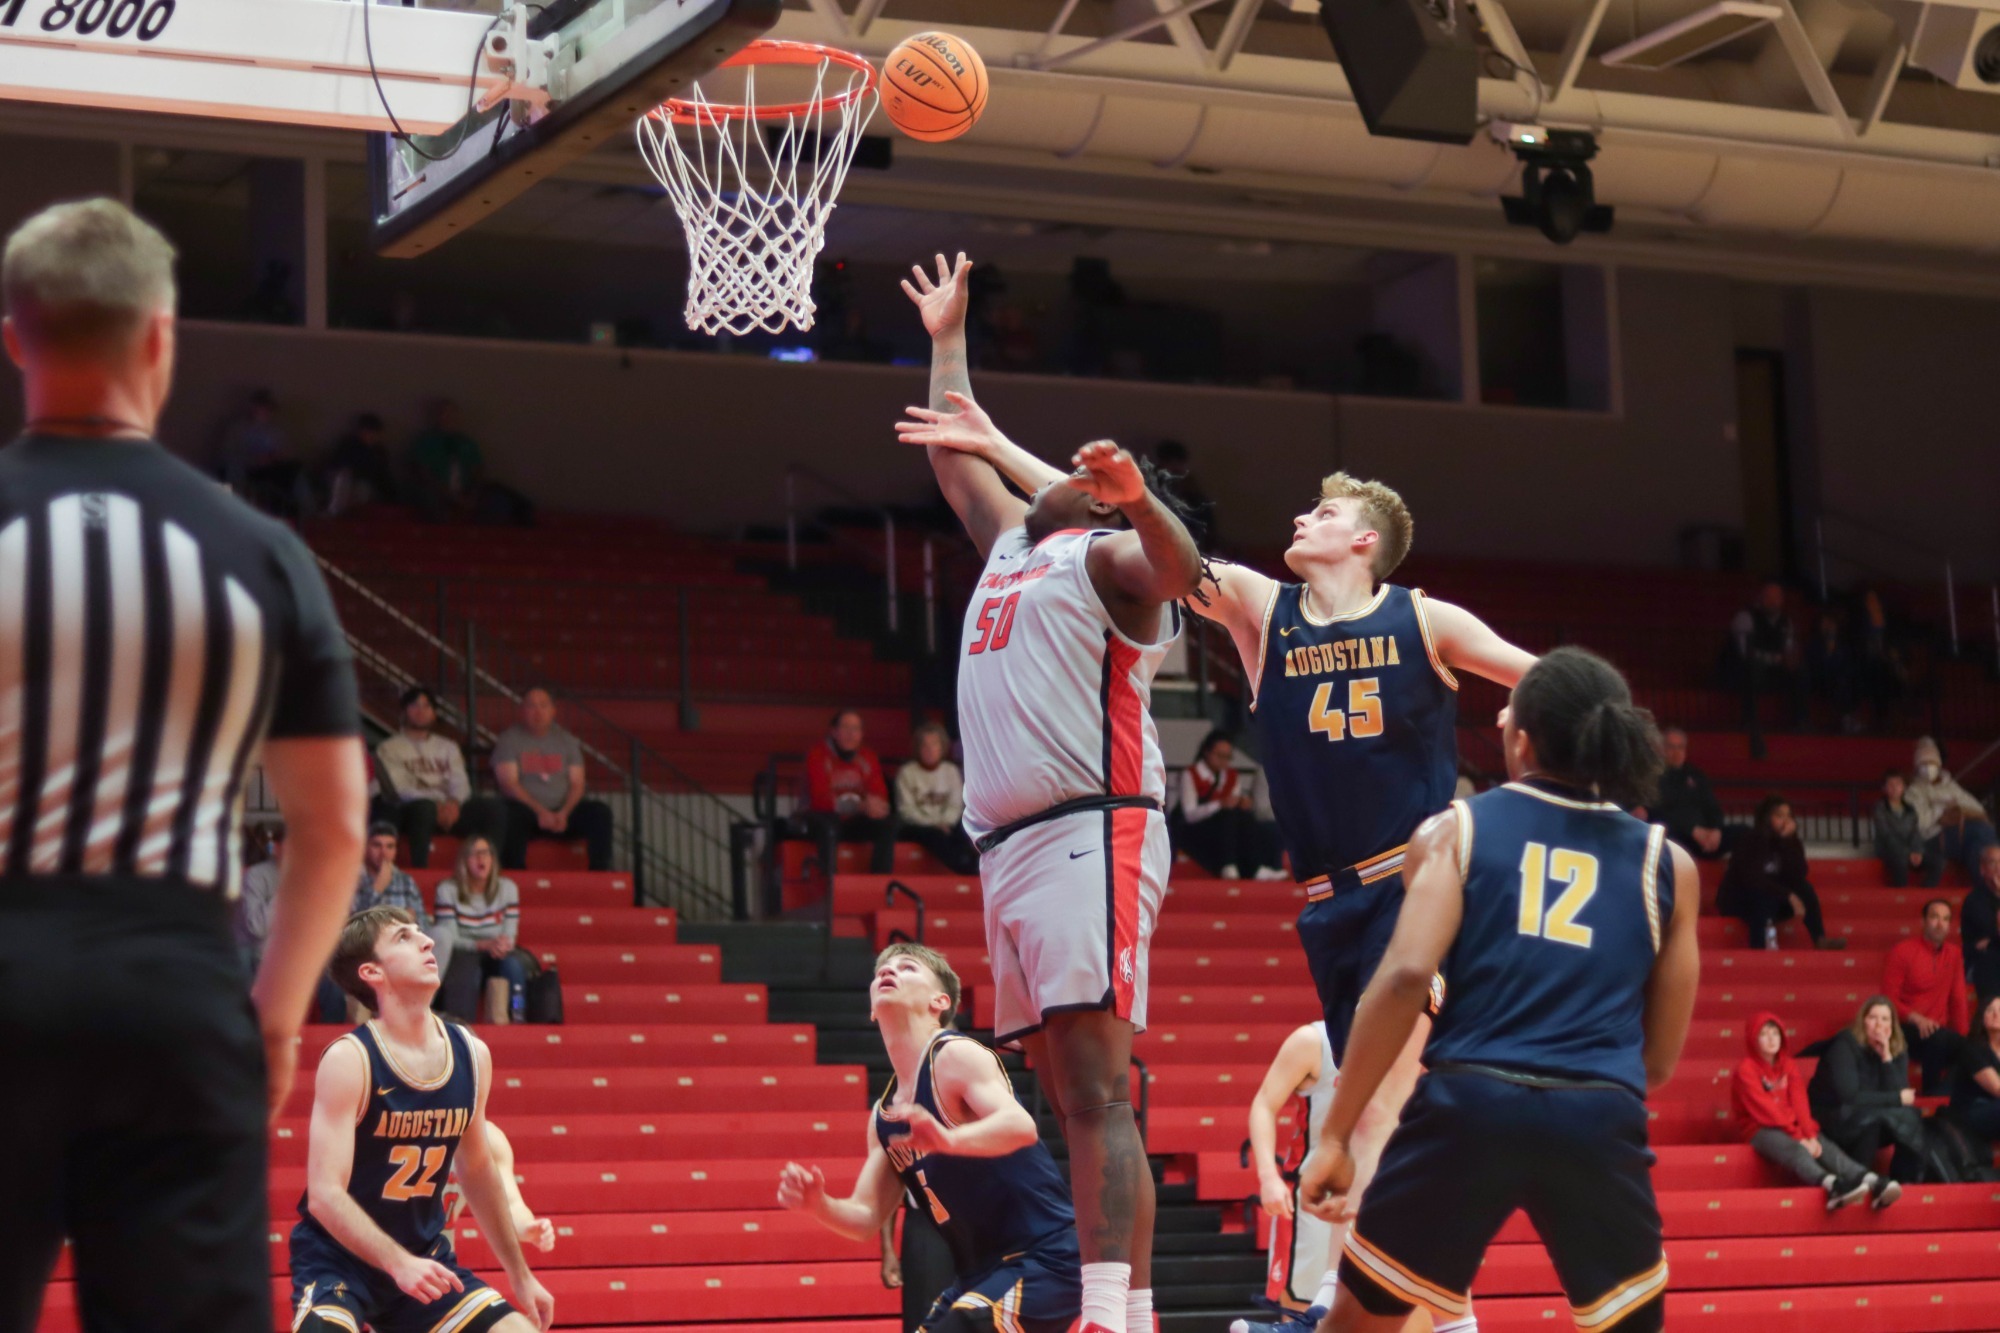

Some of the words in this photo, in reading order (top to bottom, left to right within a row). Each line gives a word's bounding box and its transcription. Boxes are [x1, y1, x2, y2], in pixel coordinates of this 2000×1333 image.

[40, 0, 176, 41] 8000
[968, 591, 1021, 655] 50
[1285, 635, 1400, 677] AUGUSTANA
[1308, 677, 1384, 742] 45
[1518, 841, 1599, 949] 12
[381, 1144, 447, 1202] 22
